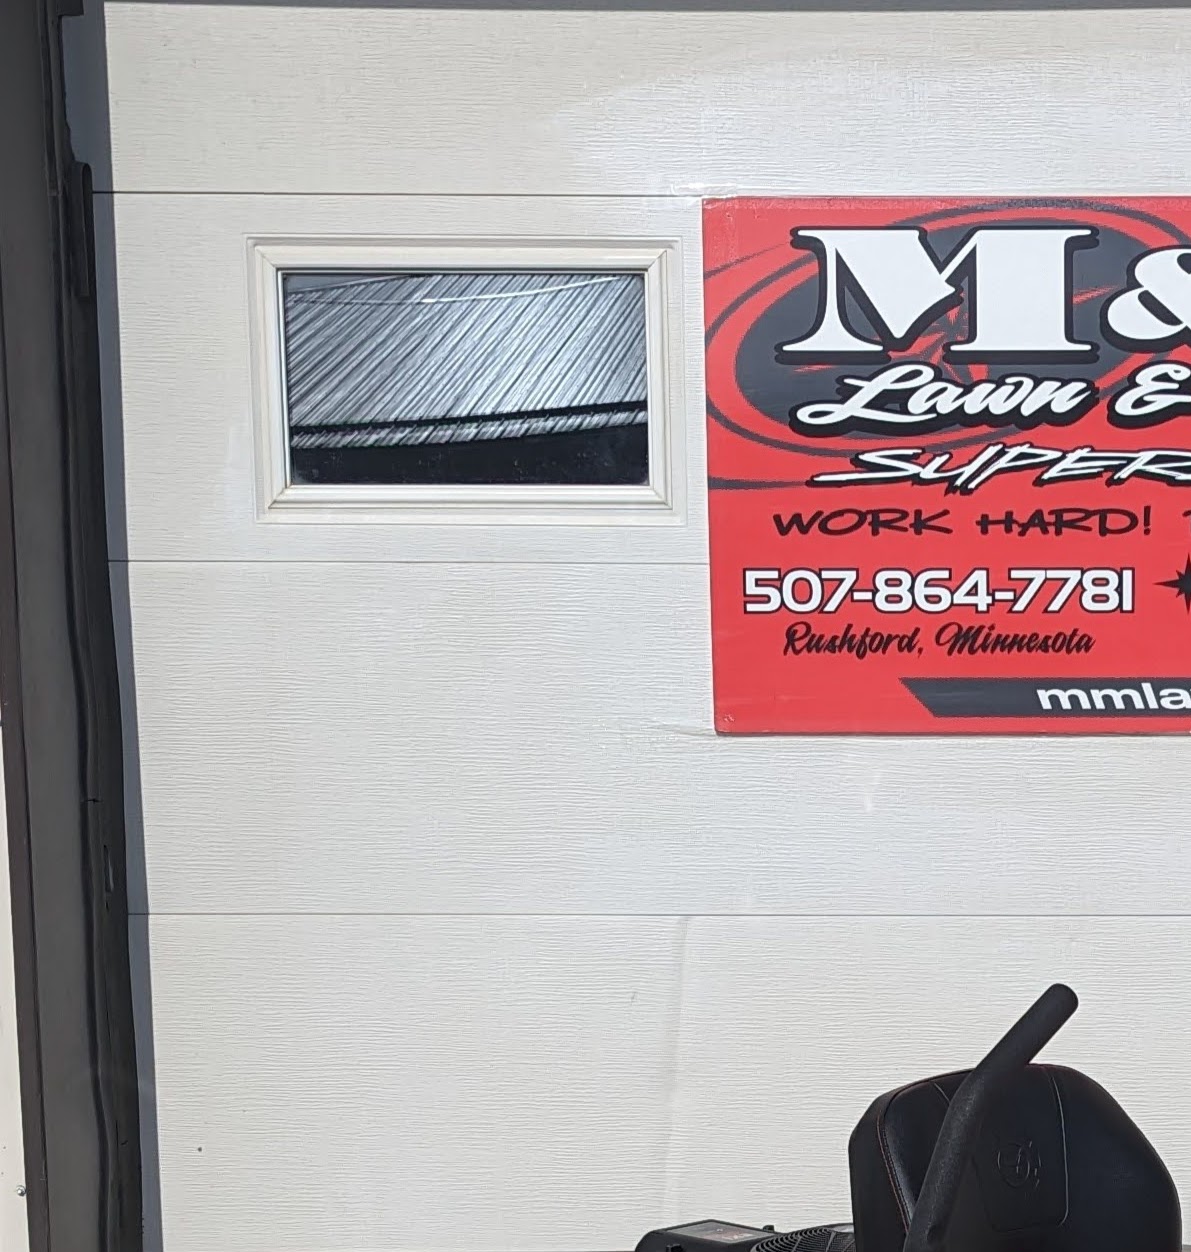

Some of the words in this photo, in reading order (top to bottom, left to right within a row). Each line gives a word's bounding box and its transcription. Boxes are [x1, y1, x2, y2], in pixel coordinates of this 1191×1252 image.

[794, 362, 1094, 430] Lawn
[773, 508, 953, 537] WORK
[975, 505, 1152, 537] HARD!
[743, 567, 1135, 614] 507-864-7781
[783, 621, 924, 660] Rushford,
[935, 622, 1096, 656] Minnesota
